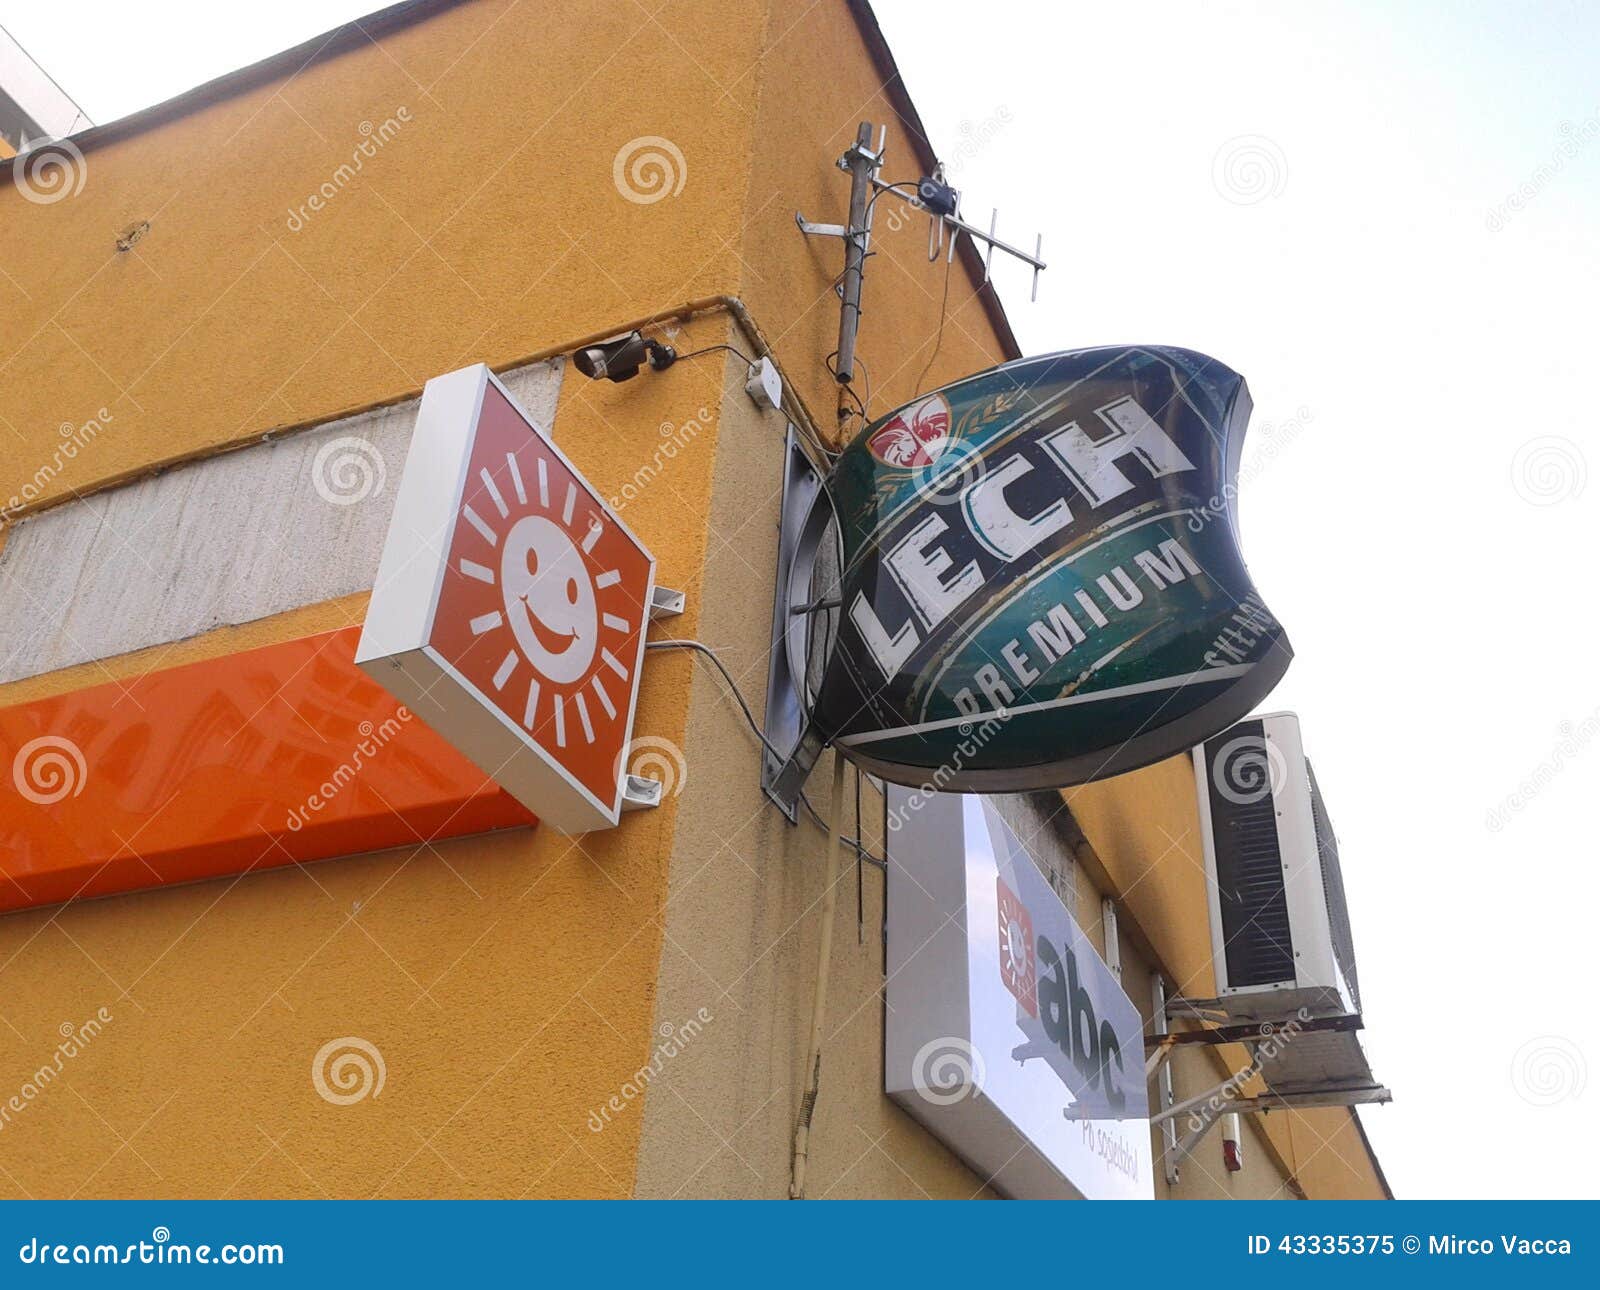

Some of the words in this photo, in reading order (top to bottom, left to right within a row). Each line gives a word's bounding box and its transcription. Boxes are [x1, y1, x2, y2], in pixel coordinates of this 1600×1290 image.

[848, 394, 1197, 685] LECH
[952, 537, 1203, 717] PREMIUM
[1036, 935, 1126, 1113] abc
